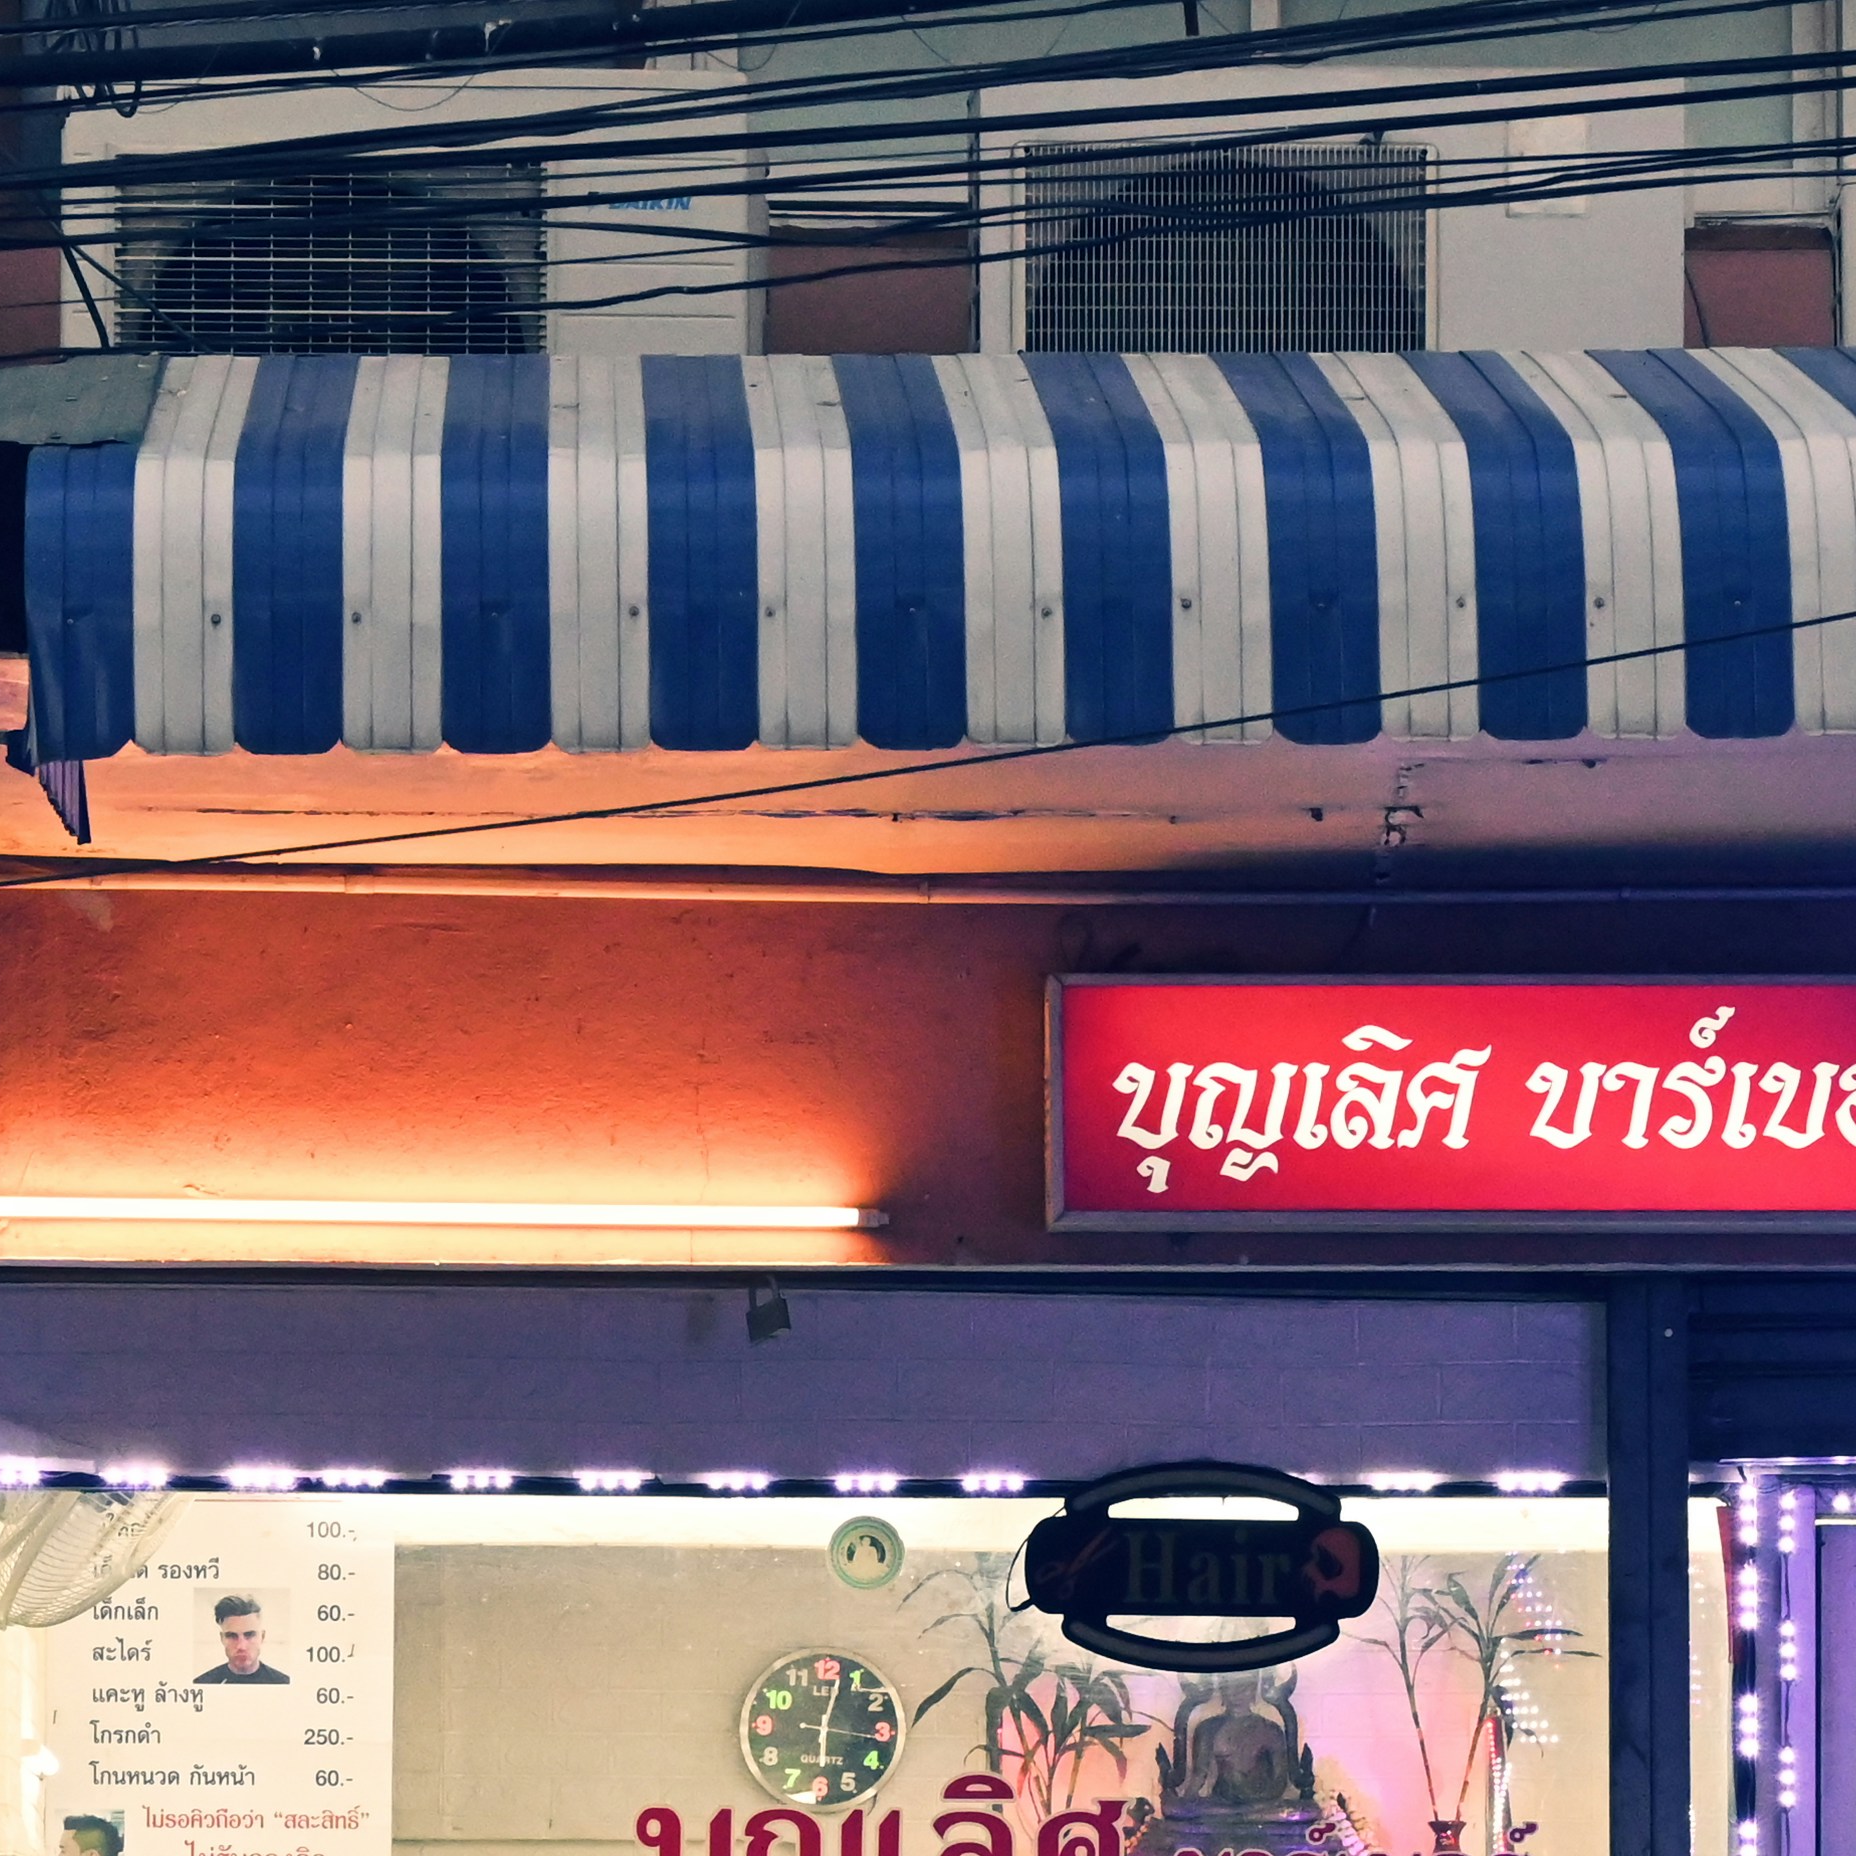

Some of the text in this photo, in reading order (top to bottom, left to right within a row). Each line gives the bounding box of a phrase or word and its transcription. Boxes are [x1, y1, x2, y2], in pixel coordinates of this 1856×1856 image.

[1112, 1024, 1492, 1193] บุญเลิศ
[307, 1521, 355, 1539] 100.-
[157, 1556, 220, 1580] รองหวี
[317, 1563, 356, 1581] 80.-
[1123, 1526, 1291, 1605] Hair
[93, 1596, 355, 1622] เด็กเล็ก 60.-
[92, 1638, 151, 1662] สะไดร์
[786, 1668, 809, 1687] 11
[814, 1660, 840, 1681] 12
[92, 1682, 354, 1712] แคะหู ล้างหู 60.-
[765, 1690, 793, 1711] 10
[867, 1693, 884, 1712] 2
[90, 1720, 354, 1747] โกรกดำ 250.-
[755, 1714, 773, 1736] 9
[875, 1721, 891, 1742] 3
[763, 1746, 779, 1767] 8
[863, 1750, 880, 1771] 4
[89, 1762, 353, 1788] โกนหนวด กันหน้า 60.-
[784, 1768, 801, 1788] 7
[840, 1772, 856, 1792] 5
[812, 1776, 829, 1797] 6
[142, 1805, 265, 1830] ไม่รอคิวถือว่า
